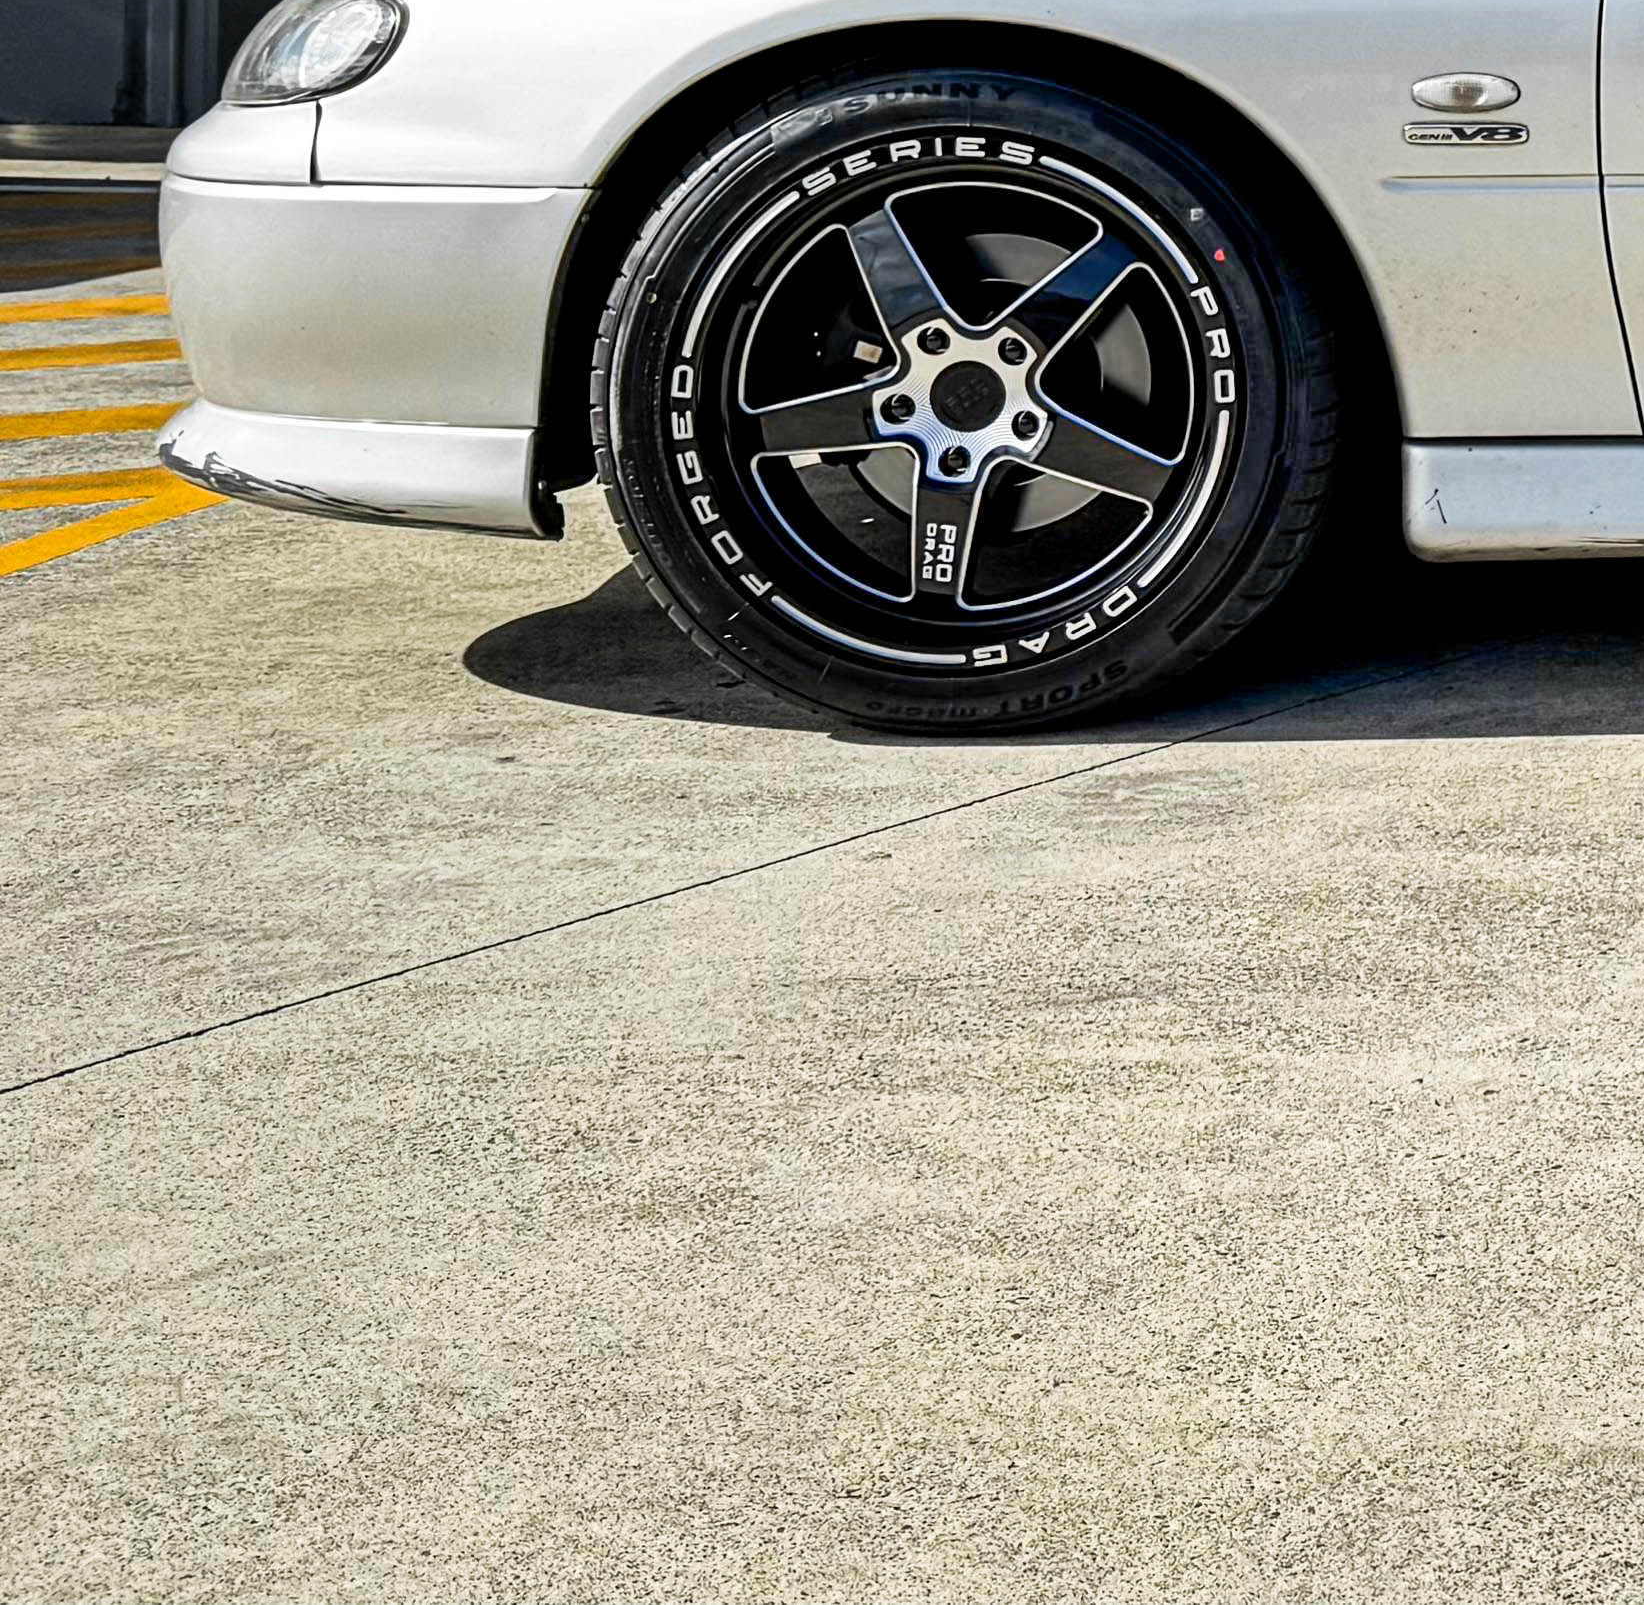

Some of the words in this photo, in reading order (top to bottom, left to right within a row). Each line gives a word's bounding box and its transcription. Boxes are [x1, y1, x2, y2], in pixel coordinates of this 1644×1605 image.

[1450, 127, 1525, 141] V8
[801, 136, 1035, 196] SERIES
[1190, 285, 1236, 404] PRO
[670, 364, 773, 599] FORGED
[922, 522, 938, 580] DRAG
[935, 524, 958, 583] PRO
[972, 584, 1139, 667] DRAG
[999, 659, 1129, 716] SPORT
